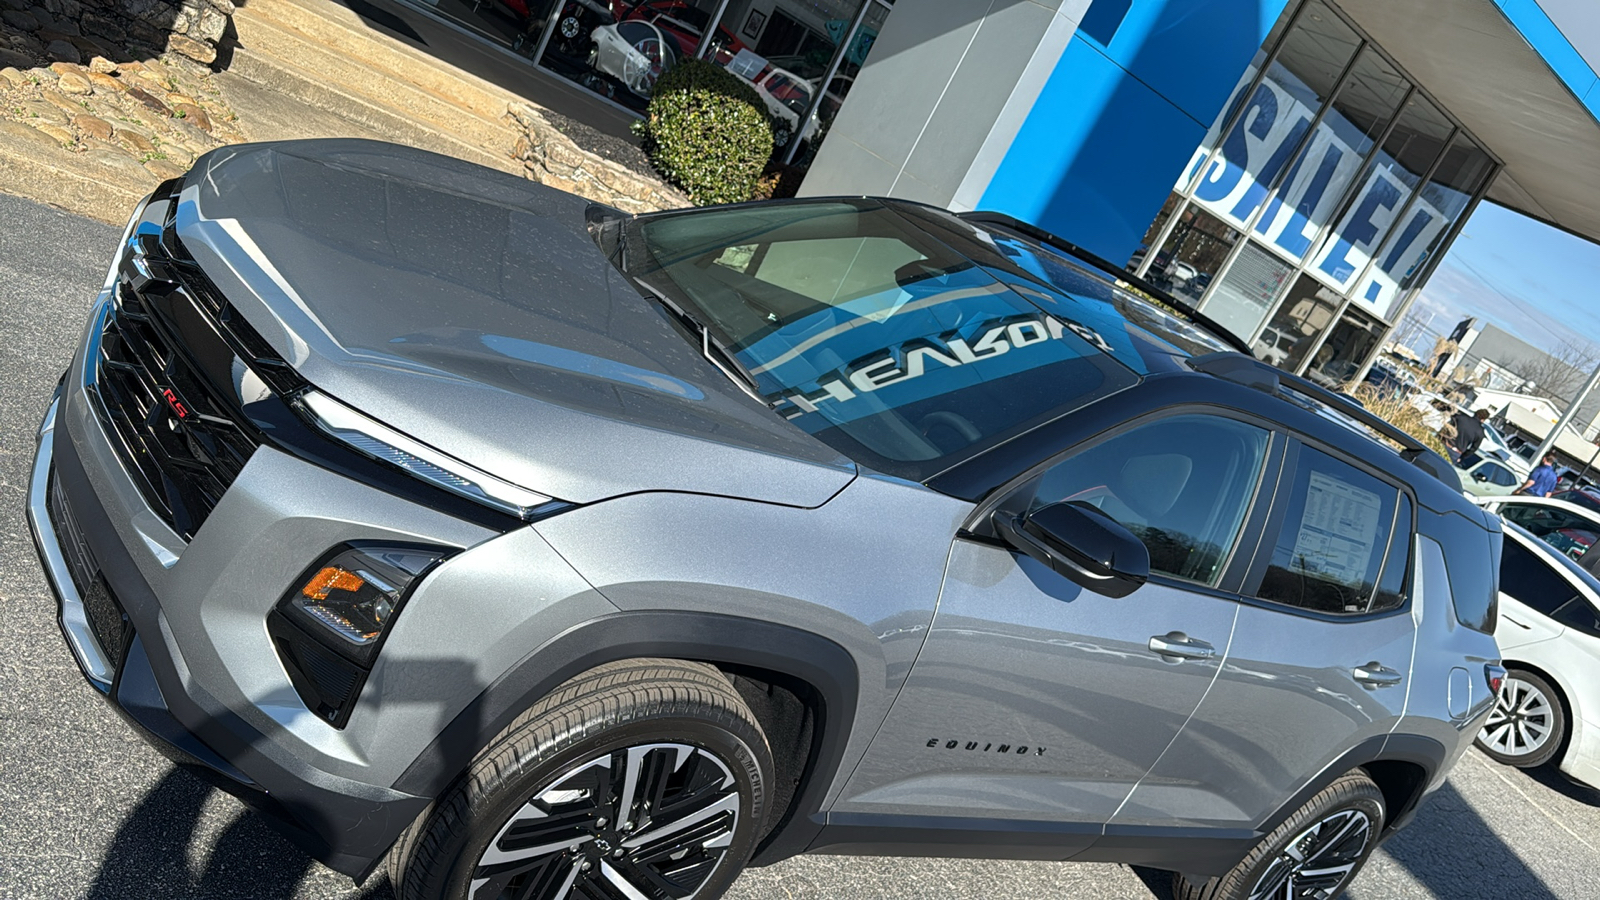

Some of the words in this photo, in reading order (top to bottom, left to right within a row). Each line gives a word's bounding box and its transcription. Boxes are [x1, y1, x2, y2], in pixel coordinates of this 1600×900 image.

[163, 388, 188, 418] RS
[926, 738, 1047, 756] EQUINOX
[745, 760, 762, 815] MICHELIN
